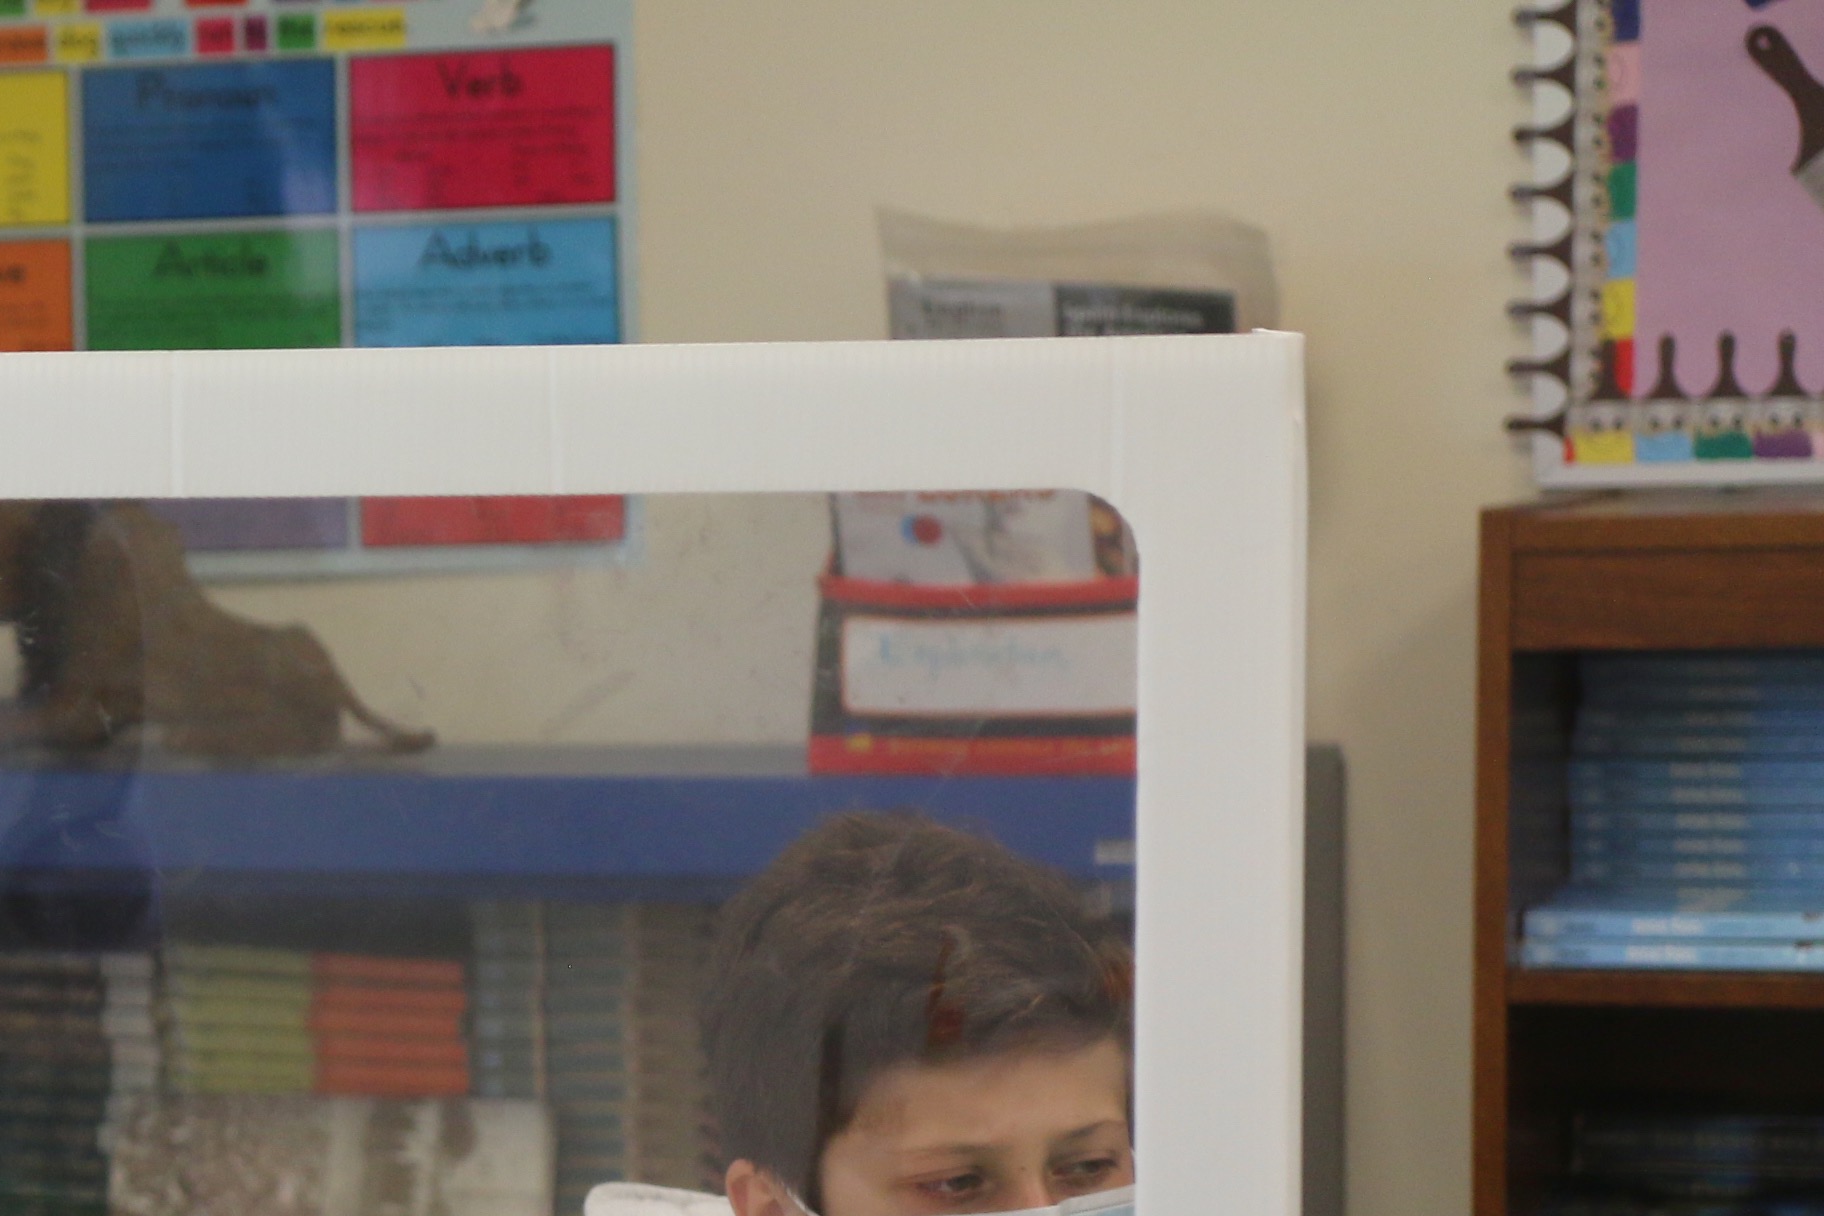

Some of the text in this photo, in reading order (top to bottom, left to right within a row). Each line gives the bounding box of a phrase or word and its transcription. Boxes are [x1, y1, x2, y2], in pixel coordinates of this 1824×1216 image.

[435, 56, 522, 98] Verb
[153, 240, 271, 278] Article
[418, 228, 552, 272] Adverb
